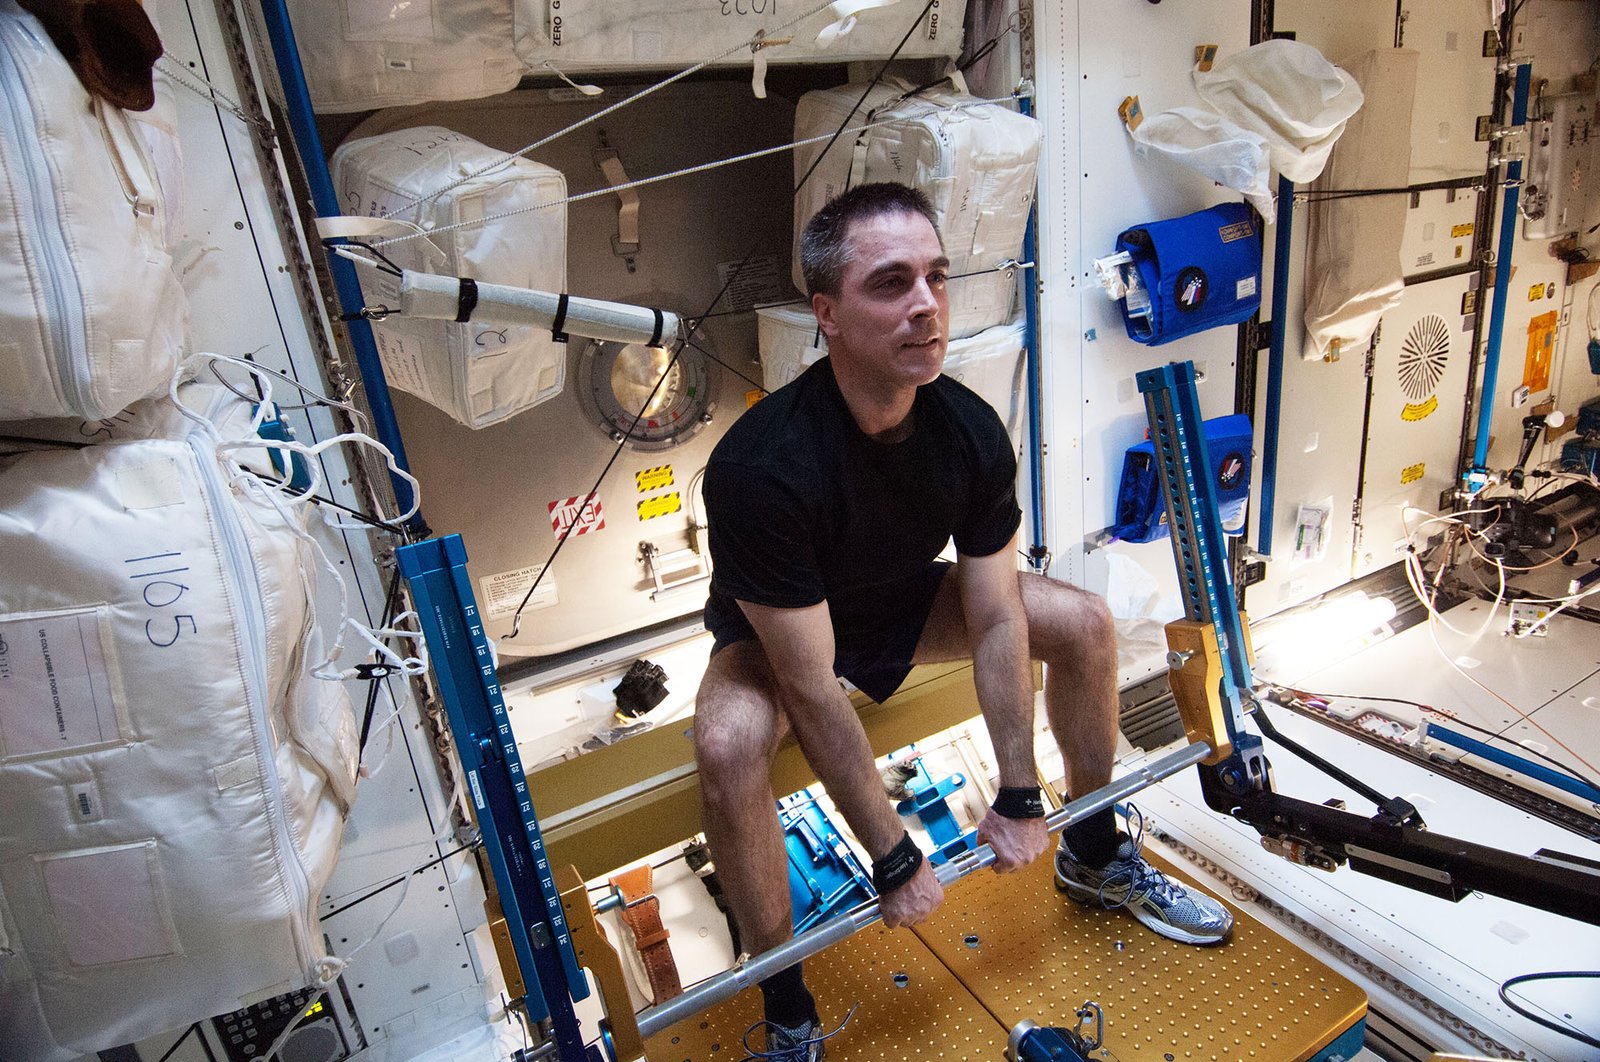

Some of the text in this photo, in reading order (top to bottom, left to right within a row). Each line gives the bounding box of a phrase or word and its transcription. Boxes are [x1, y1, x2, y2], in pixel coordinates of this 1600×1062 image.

[552, 16, 562, 47] ZERO
[928, 13, 938, 41] ZERO
[641, 471, 669, 481] WARNING
[560, 503, 597, 530] EXIT
[493, 566, 543, 582] CLOSING HATCH
[124, 552, 198, 648] 1165
[38, 629, 46, 639] US
[41, 638, 54, 679] COLLAPSIBLE
[49, 678, 59, 696] FOOD
[52, 696, 66, 733] CONTAINERS
